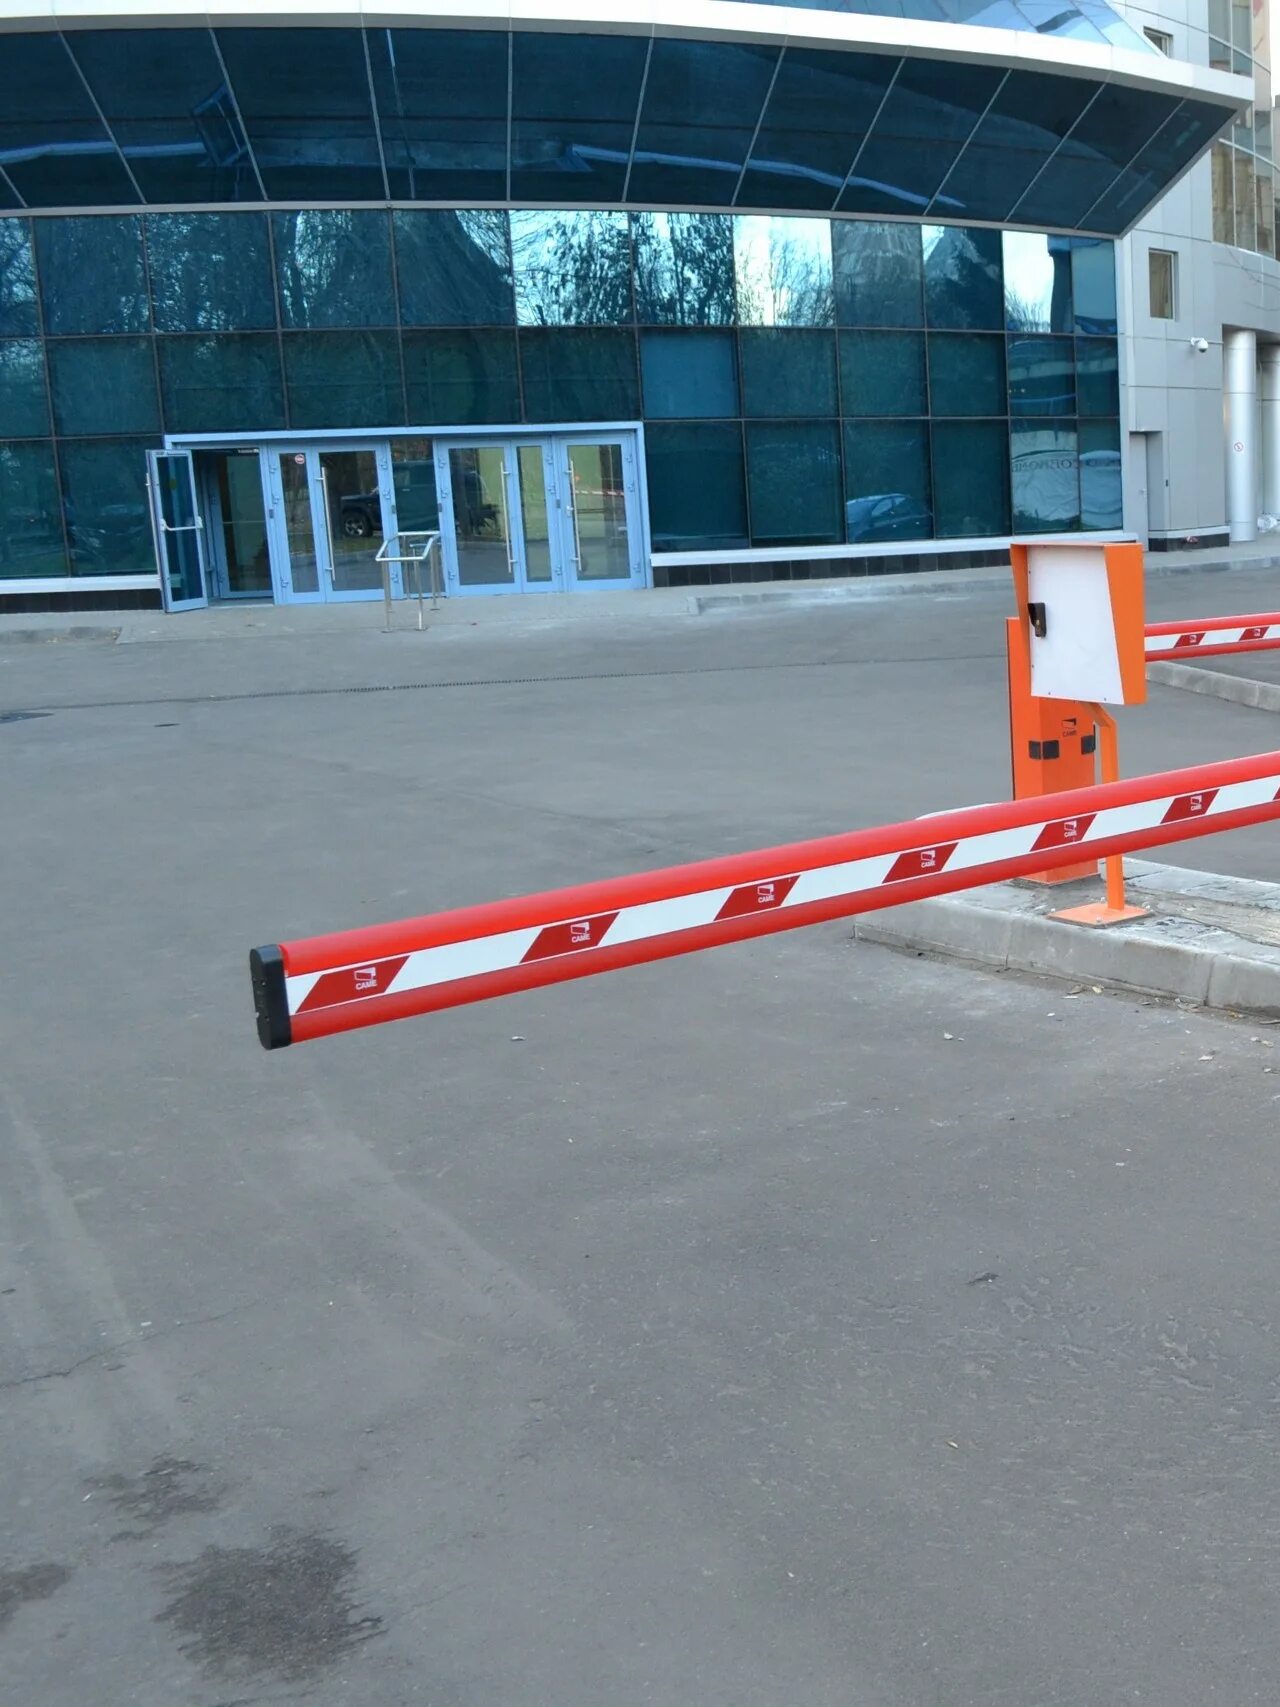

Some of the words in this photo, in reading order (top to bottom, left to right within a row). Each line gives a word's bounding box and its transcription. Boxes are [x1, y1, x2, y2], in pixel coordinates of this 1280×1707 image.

[921, 860, 936, 868] CAME
[758, 894, 775, 904] CAME
[572, 934, 591, 944] CAME
[356, 979, 378, 990] CAME
